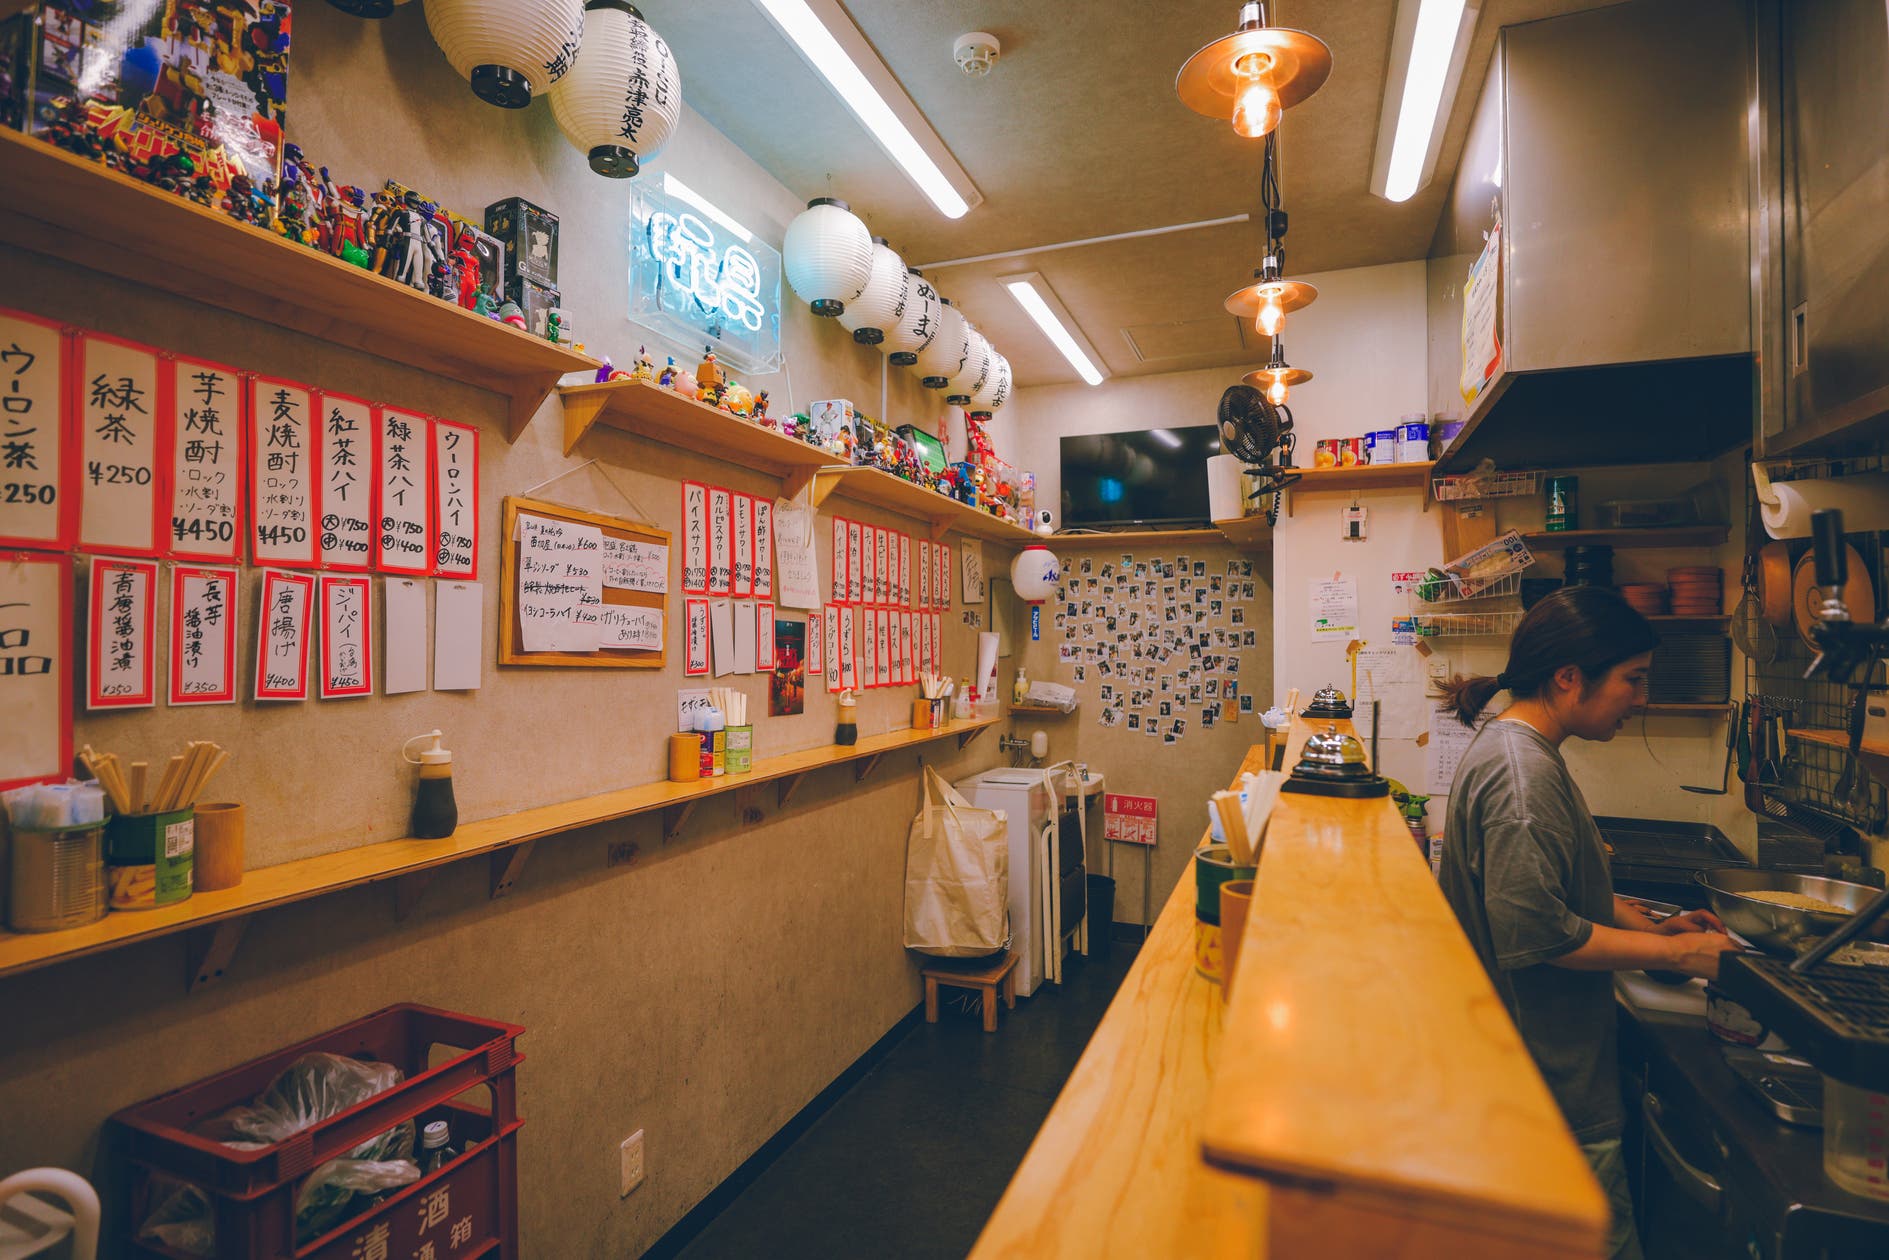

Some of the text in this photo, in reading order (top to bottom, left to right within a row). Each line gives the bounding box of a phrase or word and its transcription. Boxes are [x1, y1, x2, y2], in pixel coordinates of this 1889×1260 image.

[913, 283, 936, 338] ぬーま
[0, 343, 38, 470] ウーロン茶
[90, 374, 148, 445] 緑茶
[184, 372, 225, 464] 芋焼酎
[265, 389, 301, 474] 麦焼酎
[89, 461, 151, 486] ¥250
[328, 407, 359, 501] 紅茶ハイ
[387, 416, 414, 506] 緑茶ハイ
[445, 431, 463, 527] ウーロンハイ
[0, 483, 56, 505] 250
[172, 516, 234, 542] ¥450
[258, 525, 306, 546] ¥450
[577, 537, 597, 550] ¥600
[690, 490, 701, 566] バイスサワー
[715, 494, 724, 560] カルピスサワー
[566, 564, 588, 577] ¥530
[202, 580, 223, 626] 長芋
[271, 586, 296, 657] 唐揚げ
[336, 588, 358, 638] ジーパイ
[184, 681, 218, 694] ¥350
[265, 673, 296, 688] ¥400
[331, 676, 360, 690] ¥450
[1123, 799, 1153, 812] 消火器
